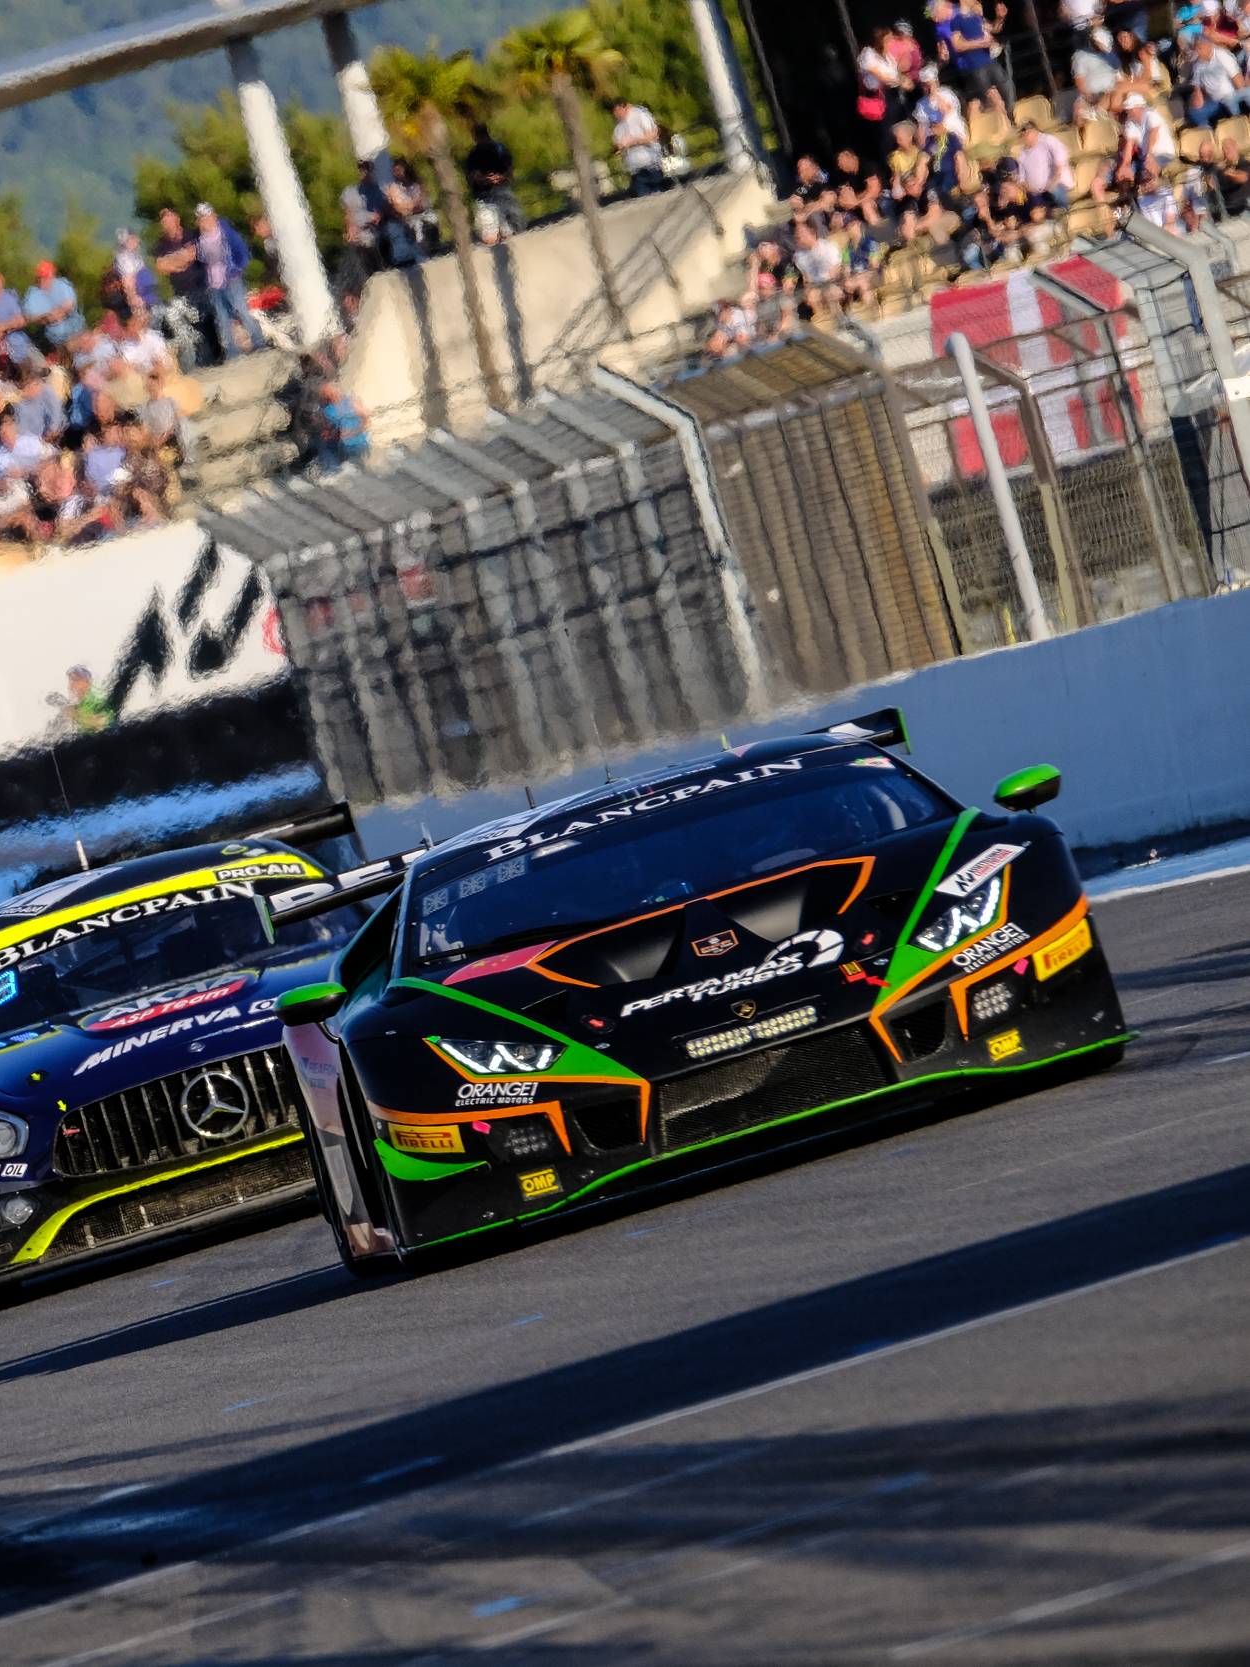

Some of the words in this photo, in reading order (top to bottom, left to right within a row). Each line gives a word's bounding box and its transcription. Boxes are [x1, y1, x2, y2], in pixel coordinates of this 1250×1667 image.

[482, 757, 803, 863] BLANCPAIN
[217, 863, 302, 882] PRO-AM
[951, 922, 1025, 967] ORANGE1
[1044, 928, 1087, 971] PIRELLI
[620, 951, 804, 1017] PERTAMAX
[691, 962, 805, 1002] TURBO
[109, 1008, 155, 1028] ASP
[73, 1006, 242, 1076] MINERVA
[989, 1035, 1021, 1057] OMP
[457, 1081, 539, 1099] ORANGE1
[455, 1097, 495, 1107] ELECTRIC
[497, 1096, 534, 1105] MOTORS
[395, 1129, 455, 1149] PIRELLI
[3, 1164, 25, 1176] OIL
[521, 1173, 557, 1193] OMP
